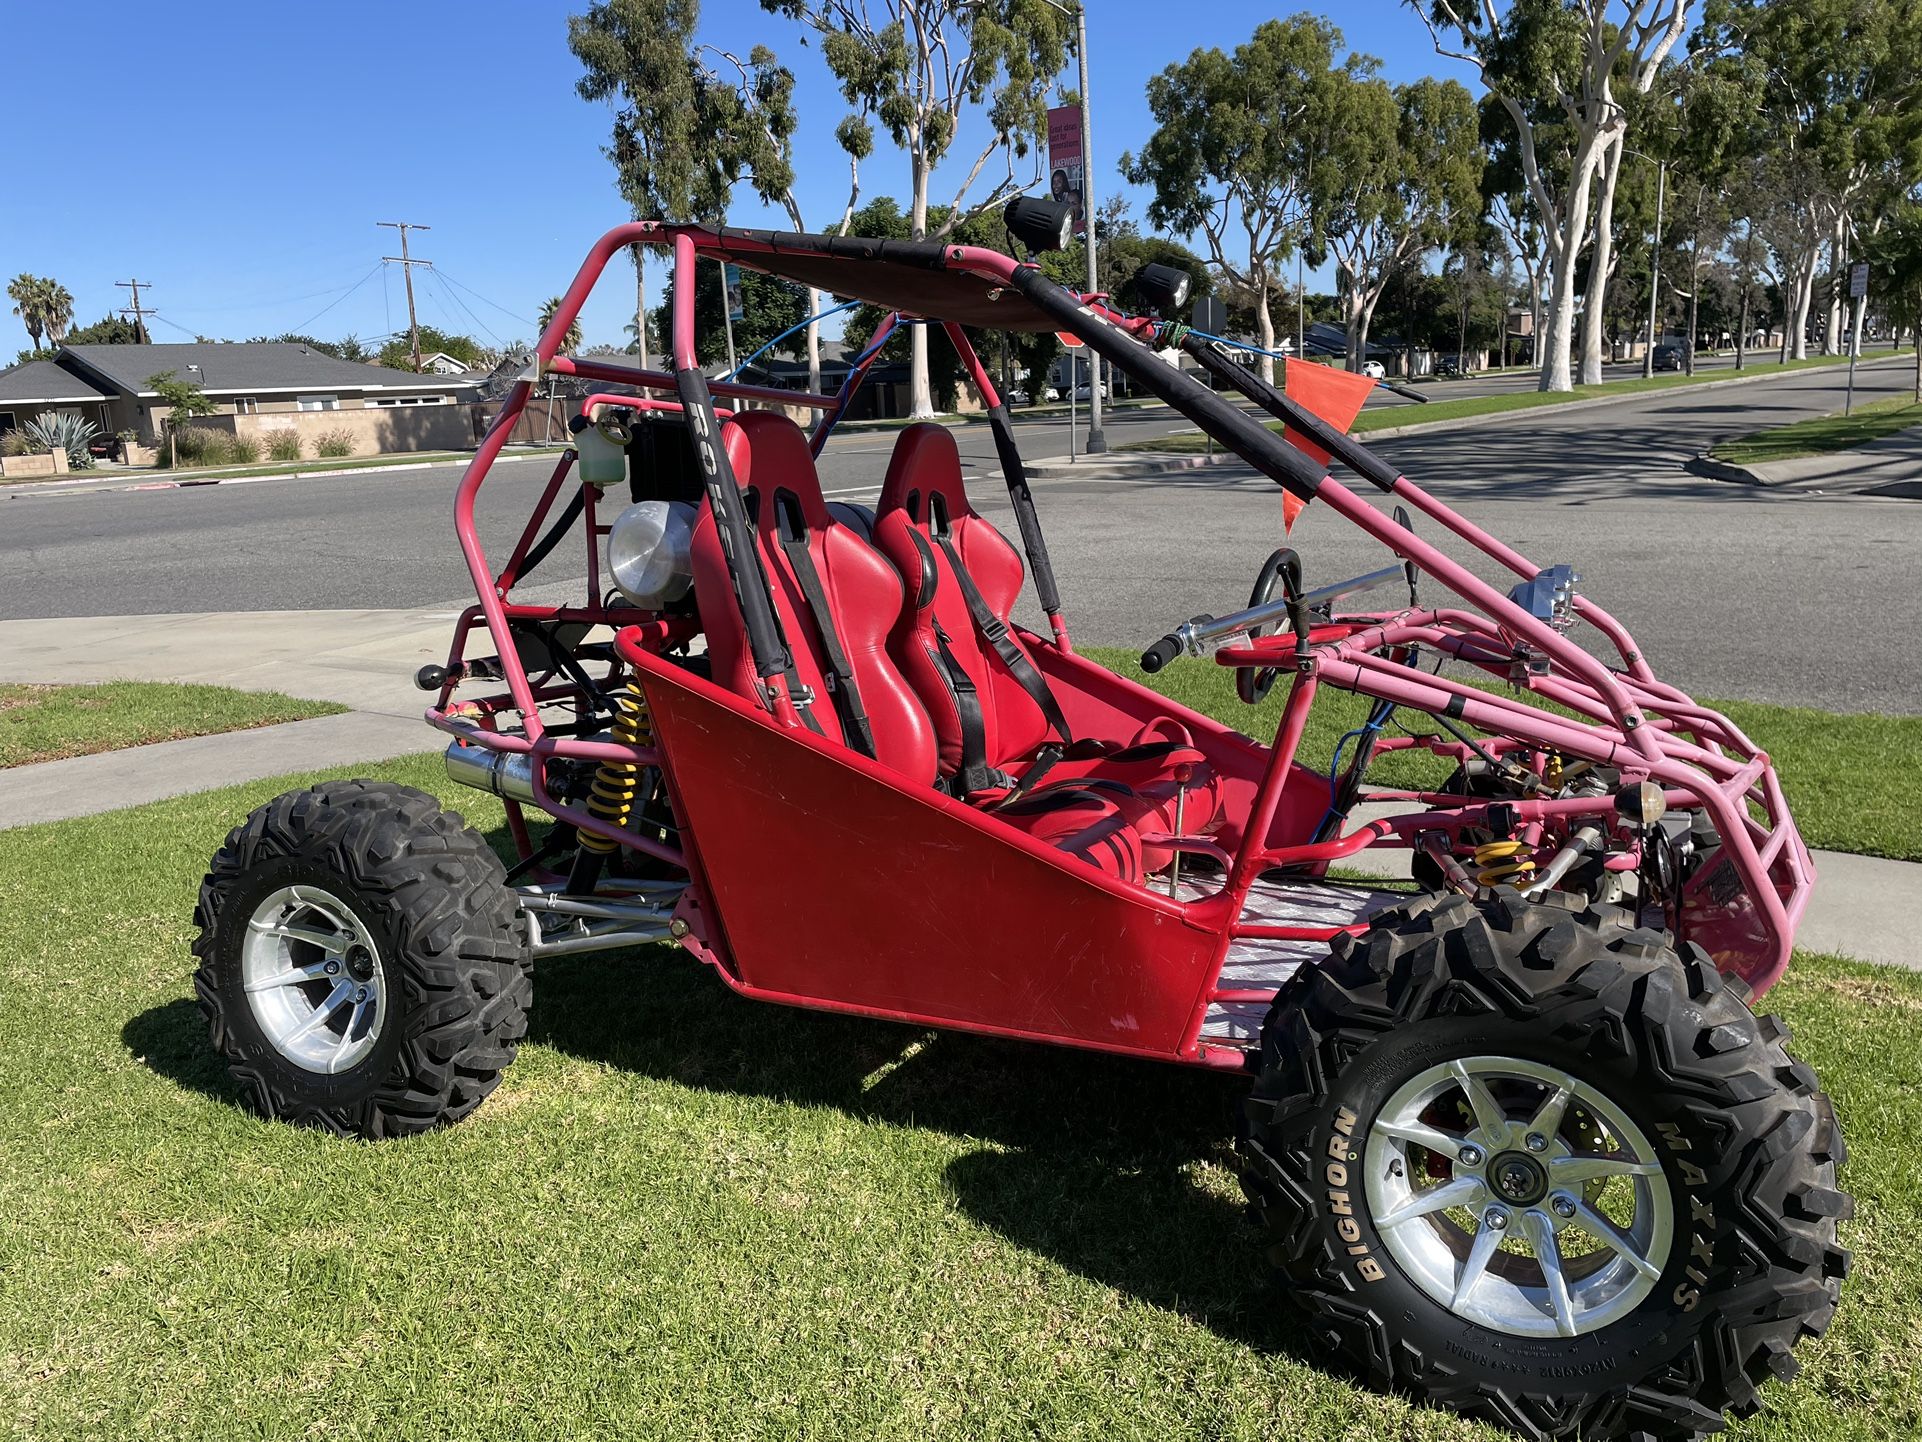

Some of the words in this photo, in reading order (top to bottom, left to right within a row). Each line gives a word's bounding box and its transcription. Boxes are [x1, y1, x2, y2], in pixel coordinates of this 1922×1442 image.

[1051, 156, 1082, 168] LAKEWOOD
[1327, 1105, 1387, 1282] BIGHORN
[1655, 1122, 1716, 1312] MAXXIS
[1445, 1339, 1489, 1368] RADIAL
